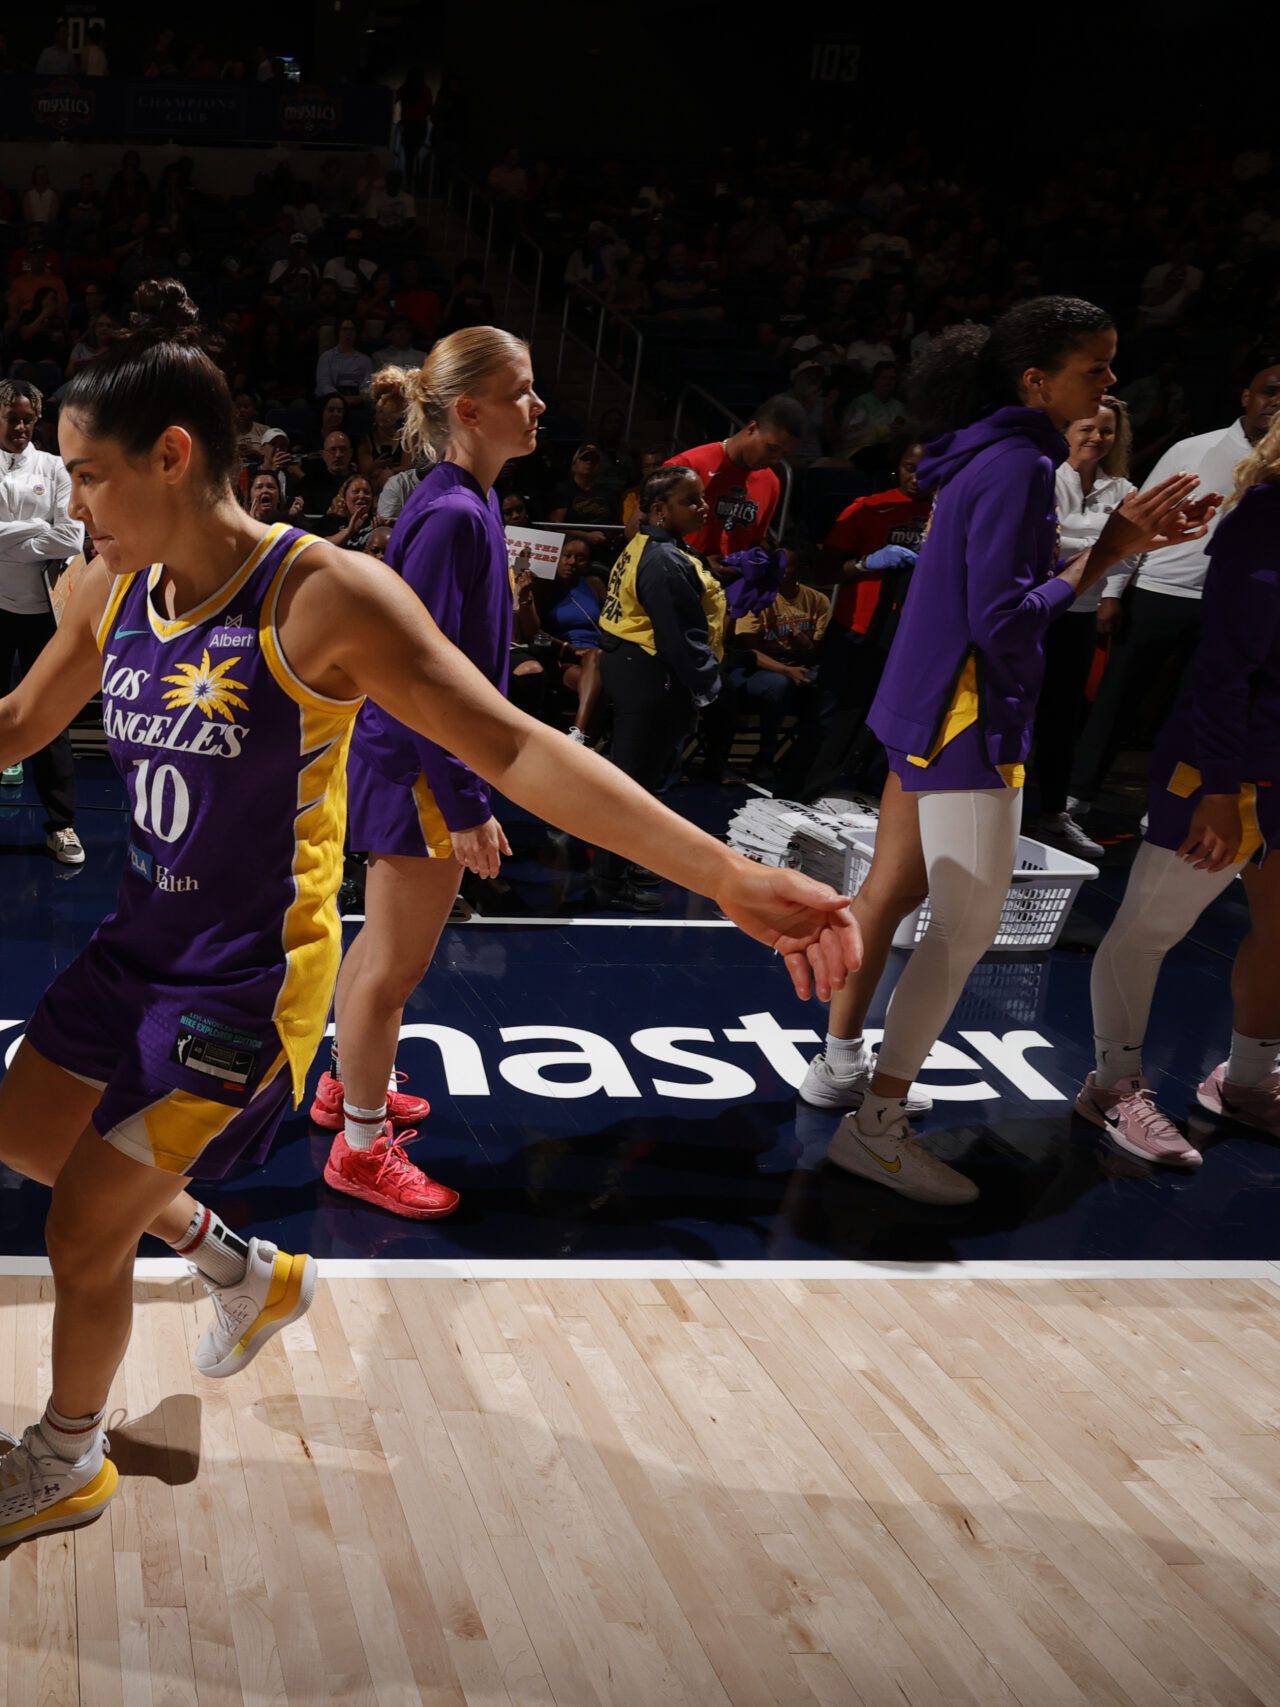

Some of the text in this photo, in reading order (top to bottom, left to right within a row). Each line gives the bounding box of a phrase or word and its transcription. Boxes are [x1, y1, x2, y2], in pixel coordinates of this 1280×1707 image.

[808, 43, 861, 81] 103
[209, 633, 254, 648] Albert
[102, 653, 150, 700] LOS
[104, 699, 250, 759] ANGELES
[132, 758, 190, 843] 10
[155, 864, 200, 892] Halth
